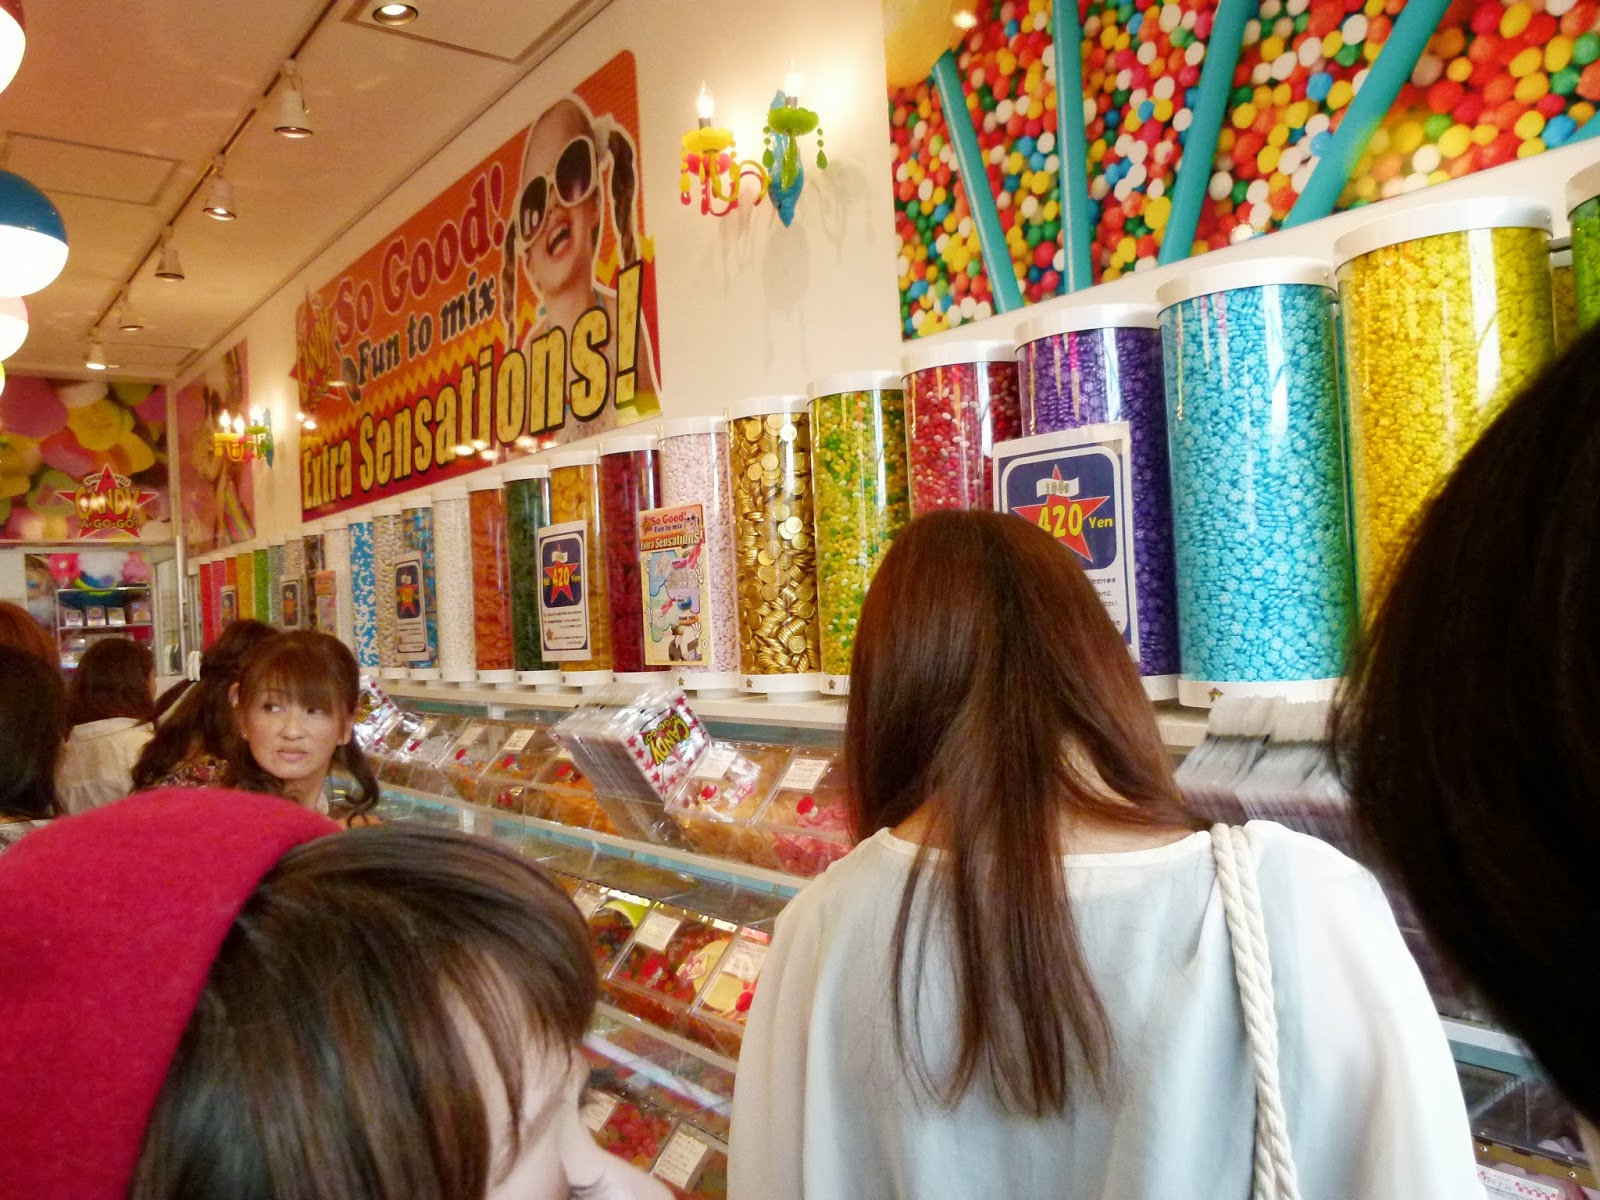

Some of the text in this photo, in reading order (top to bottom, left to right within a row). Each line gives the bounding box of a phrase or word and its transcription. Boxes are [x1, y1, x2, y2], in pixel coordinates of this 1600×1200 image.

[332, 162, 508, 346] So Good!
[356, 272, 497, 388] Fun to mix
[303, 260, 644, 511] Extra Sensations!
[75, 485, 141, 520] CANDY
[651, 511, 687, 526] So Good!
[1037, 502, 1114, 539] 420 Yen
[641, 529, 704, 550] Extra Sensations!
[653, 525, 664, 533] Fun
[552, 566, 571, 588] 420
[649, 715, 691, 767] CANDY
